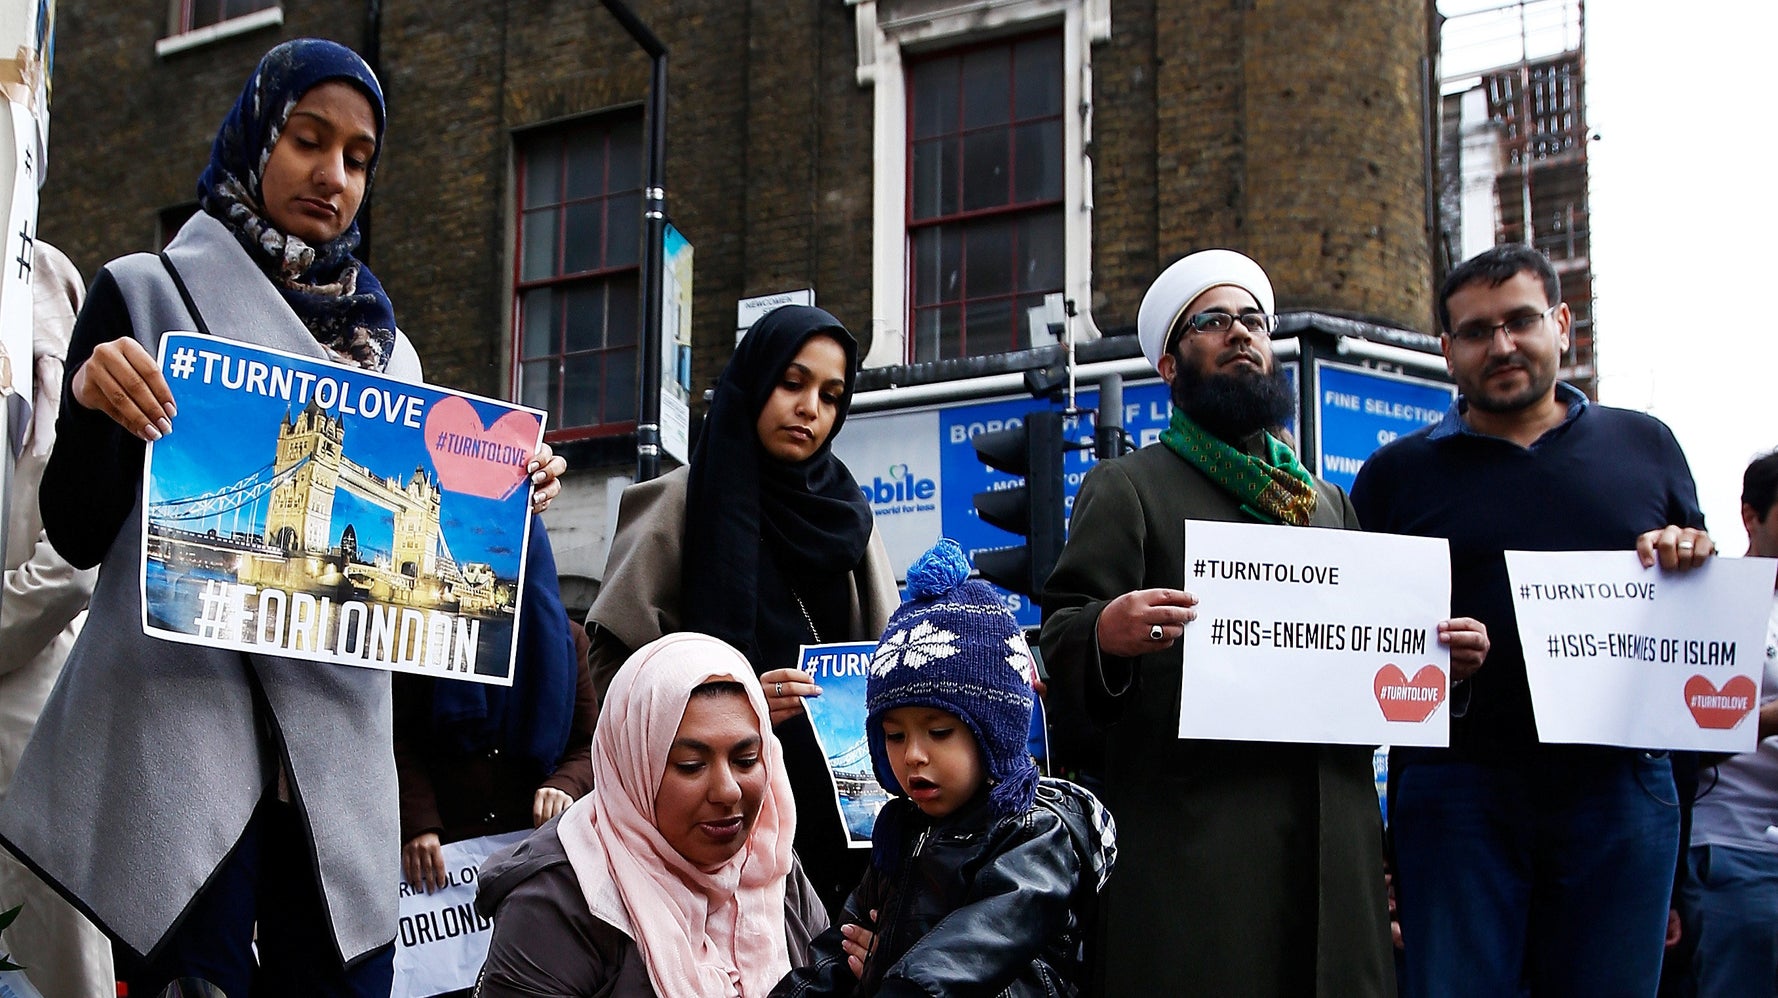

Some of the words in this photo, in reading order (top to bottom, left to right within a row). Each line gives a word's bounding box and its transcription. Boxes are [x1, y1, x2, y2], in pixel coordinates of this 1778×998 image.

[170, 347, 425, 430] #TURNTOLOVE
[1325, 390, 1361, 411] FINE
[435, 431, 527, 468] #TURNTOLOVE
[874, 505, 901, 516] world
[902, 504, 915, 513] for
[916, 503, 936, 512] less
[1194, 559, 1340, 585] #TURNTOLOVE
[1519, 582, 1656, 601] #TURNTOLOVE
[194, 579, 480, 674] #FORLONDON
[1211, 618, 1346, 651] #ISIS=ENEMIES
[1351, 625, 1373, 652] OF
[1377, 626, 1427, 655] ISLAM
[1548, 633, 1656, 662] #ISIS=ENEMIES
[1660, 639, 1679, 664] OF
[1684, 641, 1737, 666] ISLAM
[1380, 685, 1439, 701] #TURNTOLOVE
[1690, 695, 1749, 711] #TURNTOLOVE
